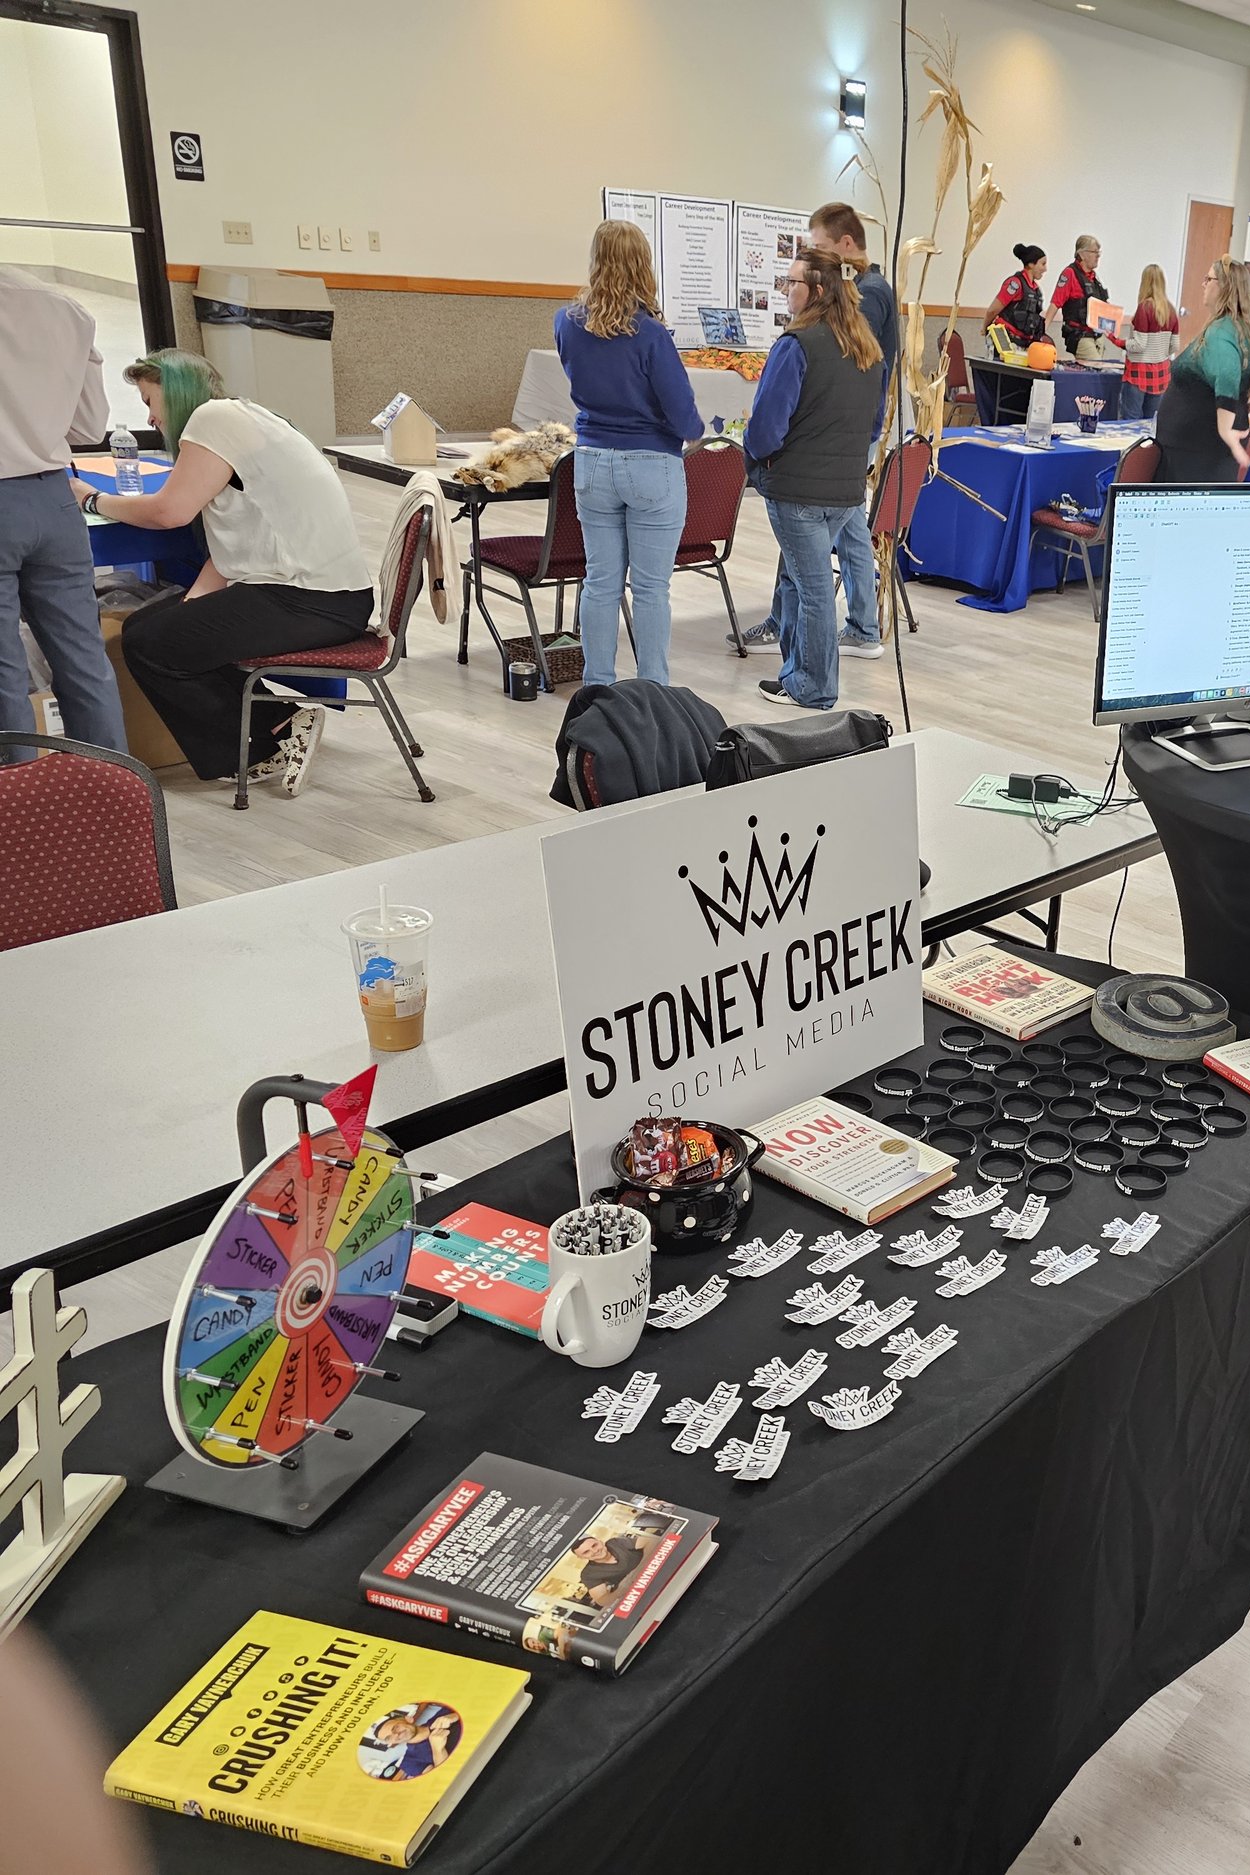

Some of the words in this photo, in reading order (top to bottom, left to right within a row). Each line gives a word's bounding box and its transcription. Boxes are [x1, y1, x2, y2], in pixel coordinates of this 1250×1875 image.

[664, 201, 683, 211] Career
[684, 204, 716, 213] Development
[742, 210, 762, 218] Career
[763, 213, 802, 224] Development
[764, 222, 777, 230] Every
[946, 978, 970, 989] JAB
[968, 968, 993, 980] JAB
[992, 959, 1017, 970] JAB
[953, 962, 1034, 997] RIGHT
[971, 970, 1054, 1006] HK
[581, 952, 770, 1100] STONEY
[785, 899, 914, 1012] CREEK
[957, 1005, 973, 1017] HOOK
[648, 1048, 766, 1119] SOCIAL
[787, 998, 875, 1056] MEDIA
[687, 1138, 699, 1163] ese's
[765, 1114, 857, 1158] NOW,
[788, 1126, 872, 1168] DISCOVER
[804, 1160, 832, 1174] YOUR
[833, 1134, 883, 1160] STRENGTHS
[338, 1155, 380, 1226] CANDY
[971, 1184, 1004, 1207] CREEK
[1020, 1196, 1043, 1223] CREEK
[346, 1190, 403, 1255] STICKER
[926, 1226, 958, 1251] CREEK
[1112, 1232, 1140, 1254] STONEY
[1131, 1214, 1154, 1234] CREEK
[227, 1238, 278, 1276] STICKER
[360, 1254, 394, 1288] PEN
[434, 1228, 519, 1284] MAKING
[444, 1230, 541, 1294] NUMBERS
[476, 1242, 545, 1290] COUNT
[733, 1255, 770, 1276] STONEY
[767, 1232, 800, 1258] CREEK
[811, 1248, 848, 1273] STONEY
[845, 1230, 879, 1252] CREEK
[1034, 1262, 1068, 1284] STONEY
[1065, 1245, 1096, 1266] CREEK
[939, 1274, 976, 1296] STONEY
[971, 1252, 1006, 1277] CREEK
[193, 1302, 256, 1342] CANDY
[328, 1303, 381, 1343] WRISTBAND
[602, 1288, 648, 1320] STONEY
[652, 1304, 693, 1326] STONEY
[689, 1278, 725, 1308] CREEK
[794, 1302, 830, 1326] STONEY
[825, 1276, 860, 1306] CREEK
[838, 1318, 880, 1348] STONEY
[878, 1298, 912, 1322] CREEK
[198, 1328, 274, 1410] WRISTBAND
[313, 1332, 344, 1399] CANDY
[886, 1346, 926, 1379] STONEY
[920, 1326, 953, 1352] CREEK
[276, 1348, 303, 1437] STICKER
[756, 1374, 796, 1408] STONEY
[793, 1350, 822, 1382] CREEK
[231, 1376, 266, 1429] PEN
[600, 1402, 632, 1440] STONEY
[622, 1372, 653, 1404] CREEK
[676, 1414, 714, 1450] STONEY
[702, 1382, 737, 1416] CREEK
[812, 1401, 856, 1422] STONEY
[859, 1384, 900, 1417] CREEK
[752, 1417, 782, 1454] CREEK
[389, 1487, 477, 1573] #ASKGARYVEE
[412, 1555, 439, 1575] ONE
[429, 1489, 504, 1557] ENTREPRENEUR'S
[423, 1555, 453, 1578] TAKE
[444, 1542, 465, 1556] ON
[456, 1494, 512, 1544] LEADERSHIP,
[453, 1506, 527, 1576] SELF-AWARENESS
[434, 1550, 472, 1582] SOCIAL
[462, 1524, 496, 1551] MEDIA
[526, 1567, 543, 1580] YORK
[618, 1588, 642, 1612] GARY
[633, 1538, 677, 1590] VAYNERCHUK
[445, 1574, 463, 1585] &
[370, 1593, 442, 1620] #ASKGARYVEE
[458, 1616, 474, 1626] GARY
[475, 1620, 511, 1638] VAYNERCHUK
[160, 1712, 203, 1743] GARY
[188, 1645, 265, 1713] VAYNERCHUK
[203, 1668, 341, 1795] CRUSHING
[314, 1636, 369, 1669] IT!
[253, 1775, 281, 1800] HOW
[274, 1745, 306, 1776] GREAT
[300, 1671, 368, 1746] ENTREPRENEURS
[361, 1646, 389, 1672] BUILD
[304, 1757, 328, 1778] AND
[321, 1734, 346, 1757] HOW
[340, 1715, 362, 1734] YOU
[356, 1693, 381, 1715] CAN,
[374, 1675, 395, 1693] TOO
[270, 1770, 301, 1799] THEIR
[295, 1725, 339, 1770] BUSINESS
[332, 1706, 355, 1725] AND
[209, 1807, 278, 1838] CRUSHING
[282, 1825, 298, 1842] IT!
